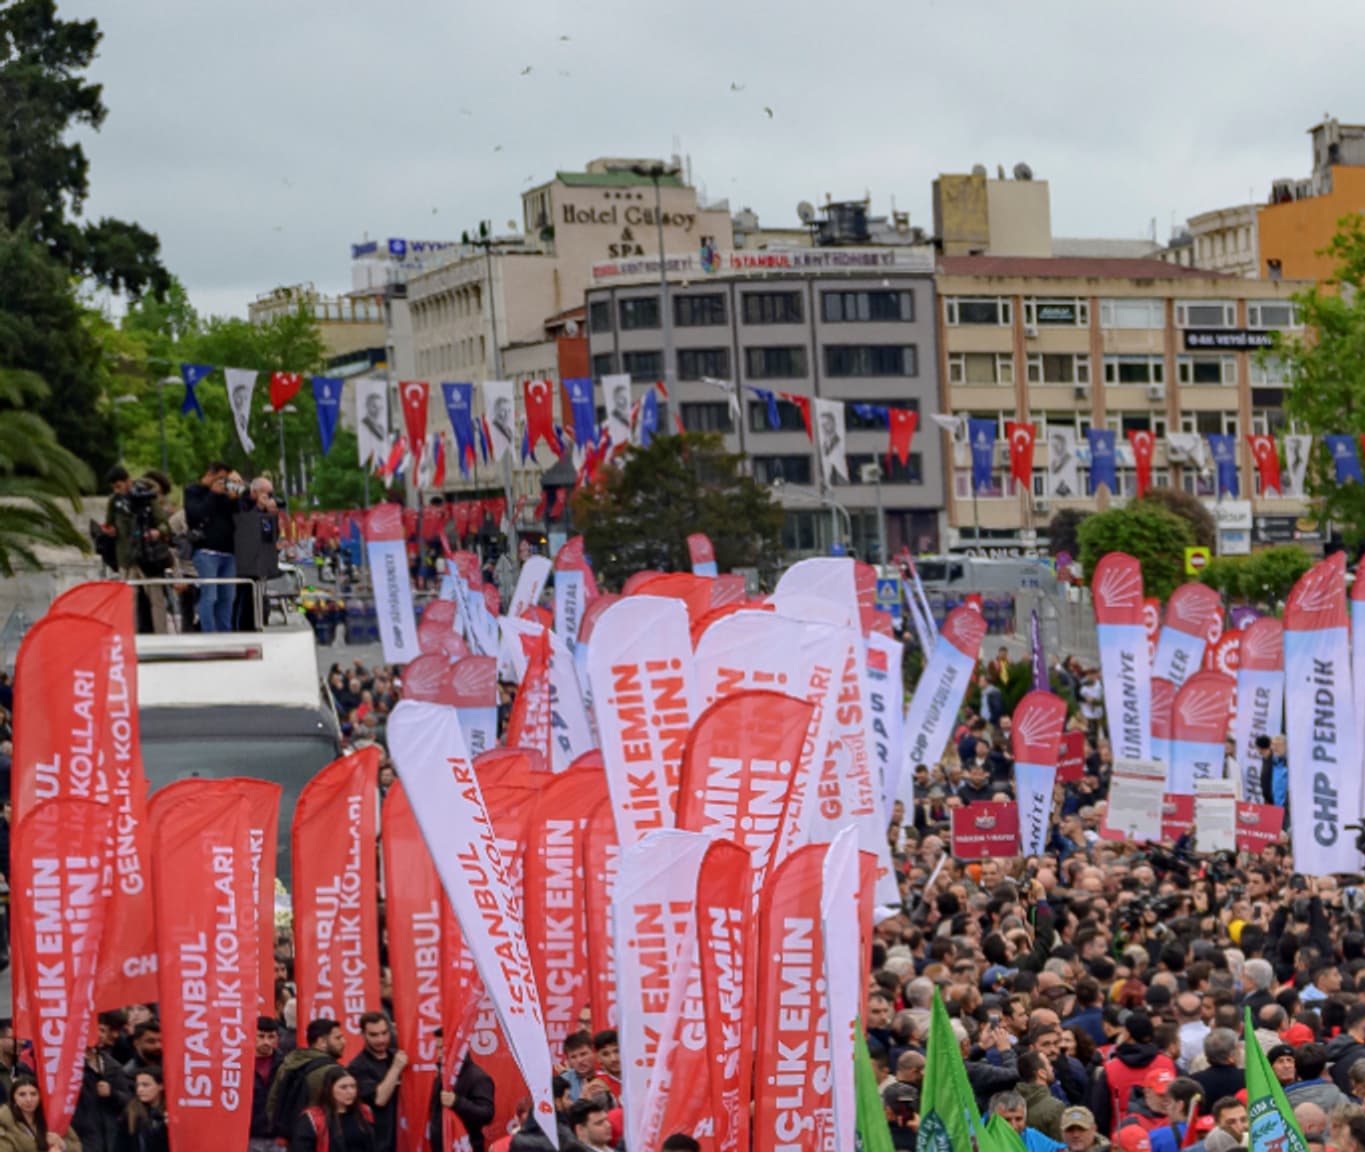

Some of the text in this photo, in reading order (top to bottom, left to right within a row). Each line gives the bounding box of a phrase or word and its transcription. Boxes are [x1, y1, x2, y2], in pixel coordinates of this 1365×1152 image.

[563, 204, 618, 224] Hotel
[608, 243, 646, 258] SPA
[608, 663, 655, 764] EMİN
[1306, 658, 1340, 849] CHP PENDİK
[115, 764, 145, 896] GENÇLİK
[538, 819, 575, 901] EMİN
[26, 857, 63, 954] EMİN
[456, 840, 526, 1016] İSTANBUL
[628, 903, 670, 1014] EMİN
[178, 930, 214, 1108] İSTANBUL
[212, 844, 245, 1113] GENÇLİK KOLLARI
[334, 932, 371, 1036] GENÇLİK
[411, 899, 441, 1073] İSTANBUL
[763, 916, 814, 1032] EMİN
